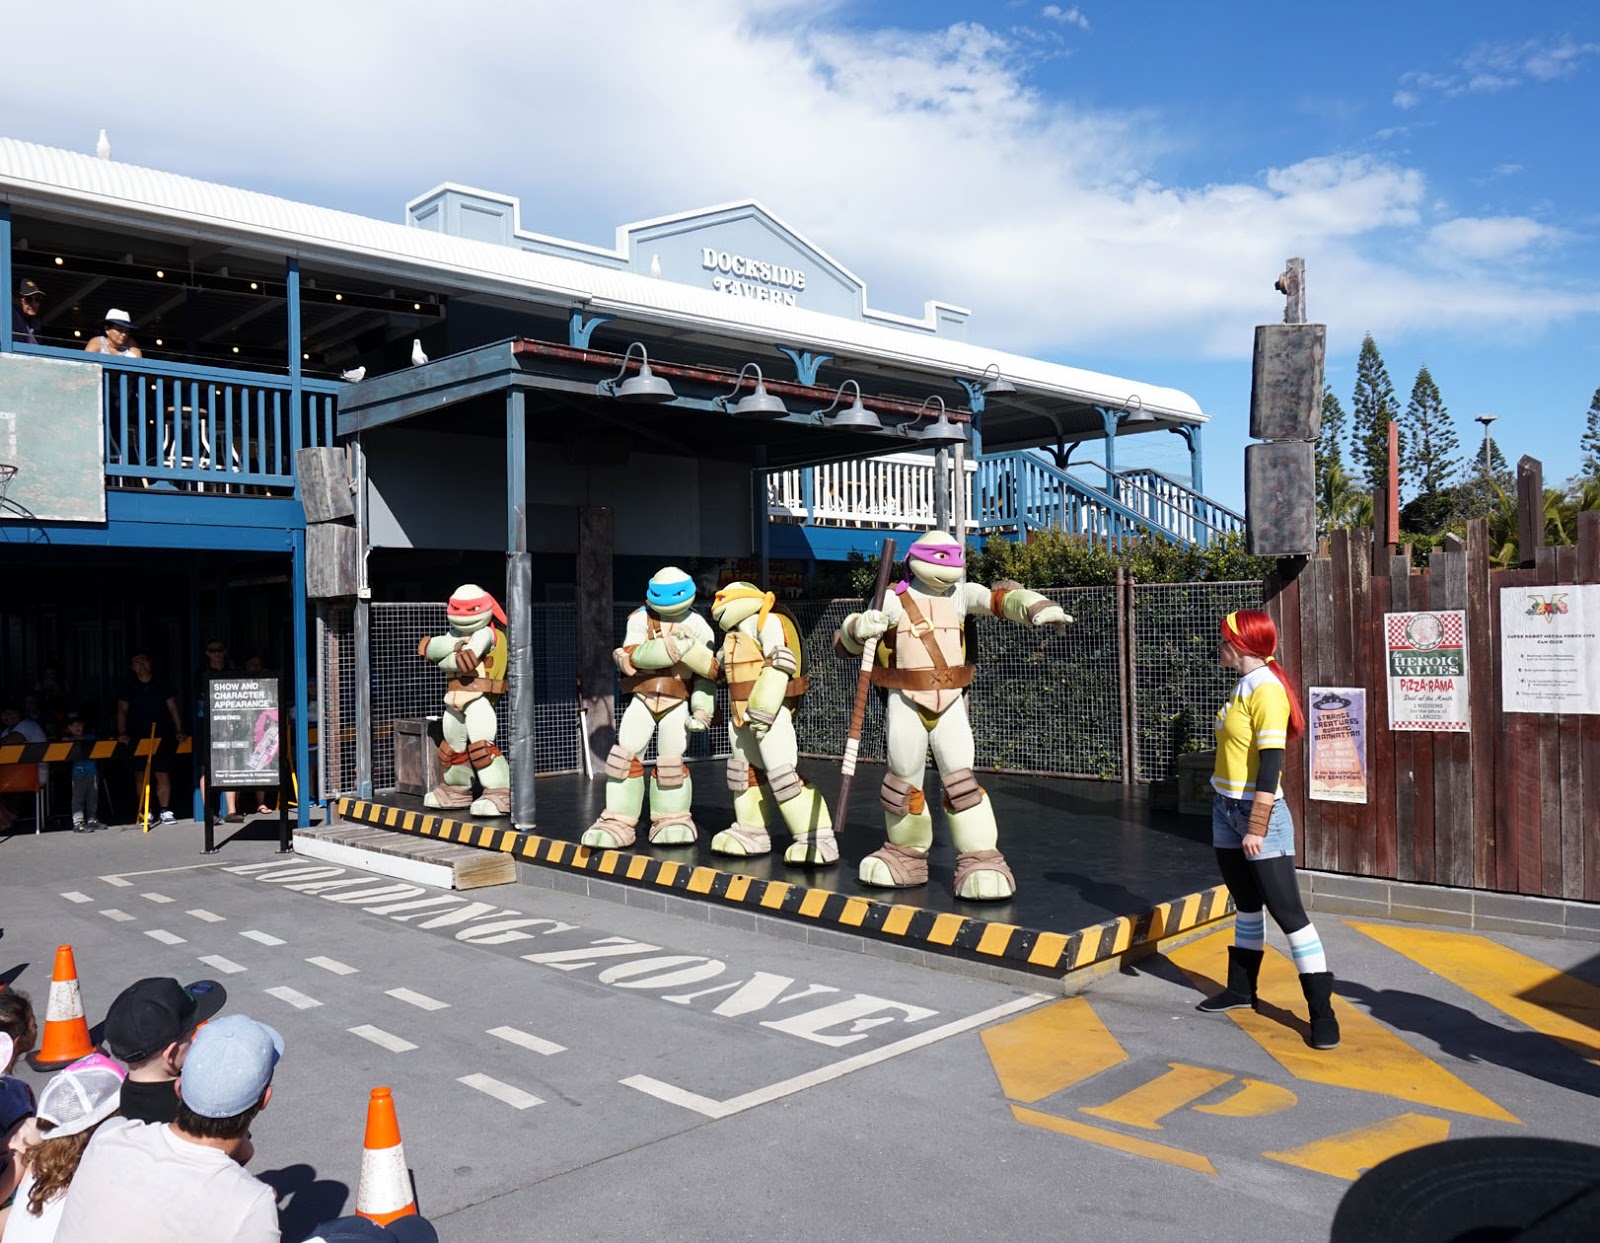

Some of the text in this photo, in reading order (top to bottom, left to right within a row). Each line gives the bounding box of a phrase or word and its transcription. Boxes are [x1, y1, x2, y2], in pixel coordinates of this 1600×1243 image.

[701, 247, 806, 292] DOCKSIDE
[712, 276, 797, 307] TAVERN
[1394, 656, 1459, 666] HEROIC
[1394, 666, 1460, 675] VALUES
[214, 682, 259, 691] SHOW AND
[214, 691, 265, 700] CHARACTER
[214, 700, 270, 708] APPEARANCE
[1317, 712, 1350, 721] STRANGE
[1313, 718, 1359, 729] CREATURES
[1314, 730, 1361, 741] MANHATTAN
[221, 857, 940, 1048] LOADING ZONE
